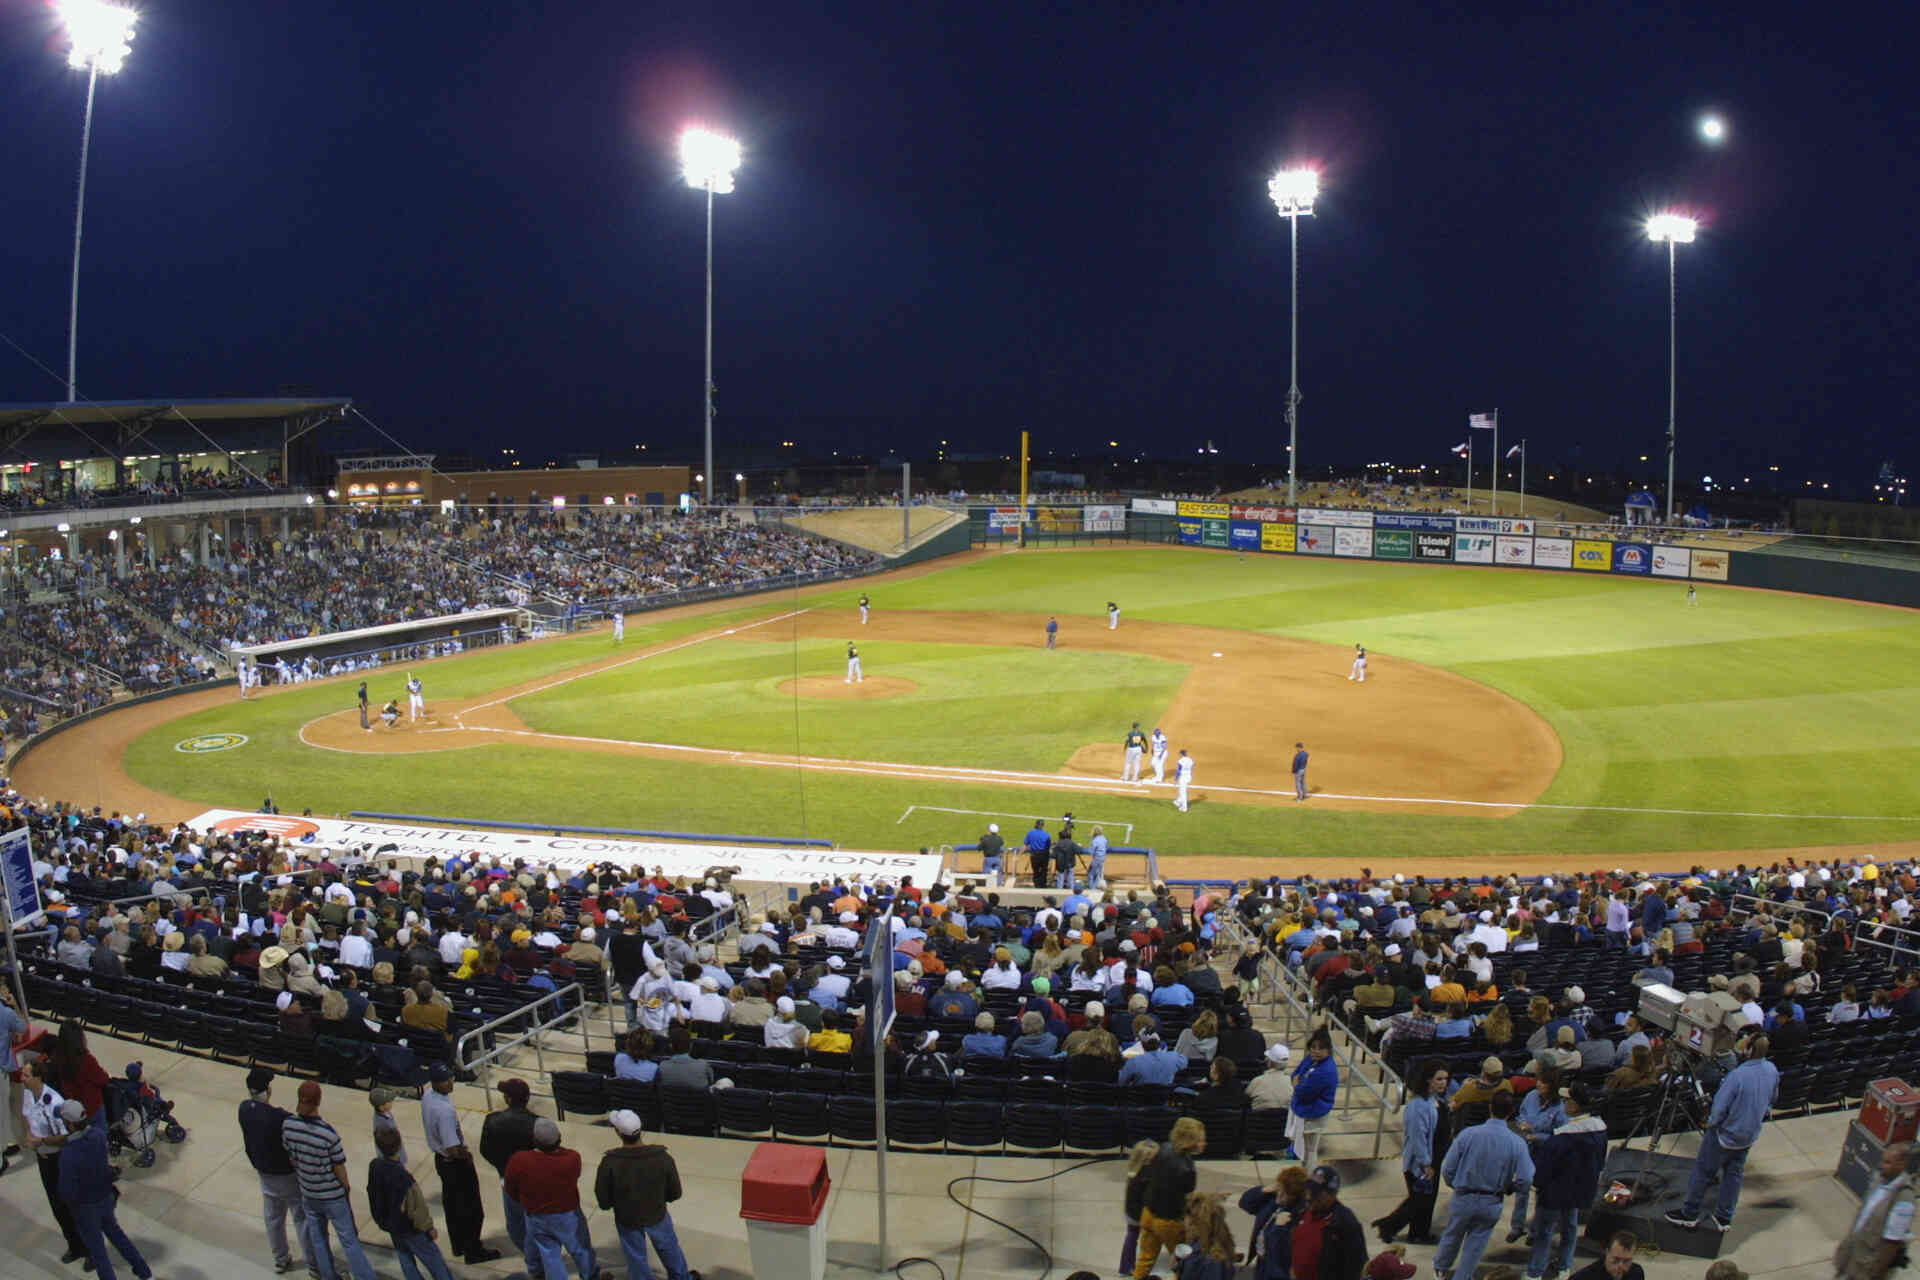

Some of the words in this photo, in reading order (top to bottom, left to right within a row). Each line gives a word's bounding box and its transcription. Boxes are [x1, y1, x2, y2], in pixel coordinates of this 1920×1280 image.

[1418, 535, 1450, 546] Island
[1421, 546, 1446, 557] Tans
[343, 822, 496, 844] TECHTEL
[1690, 1027, 1703, 1045] 2
